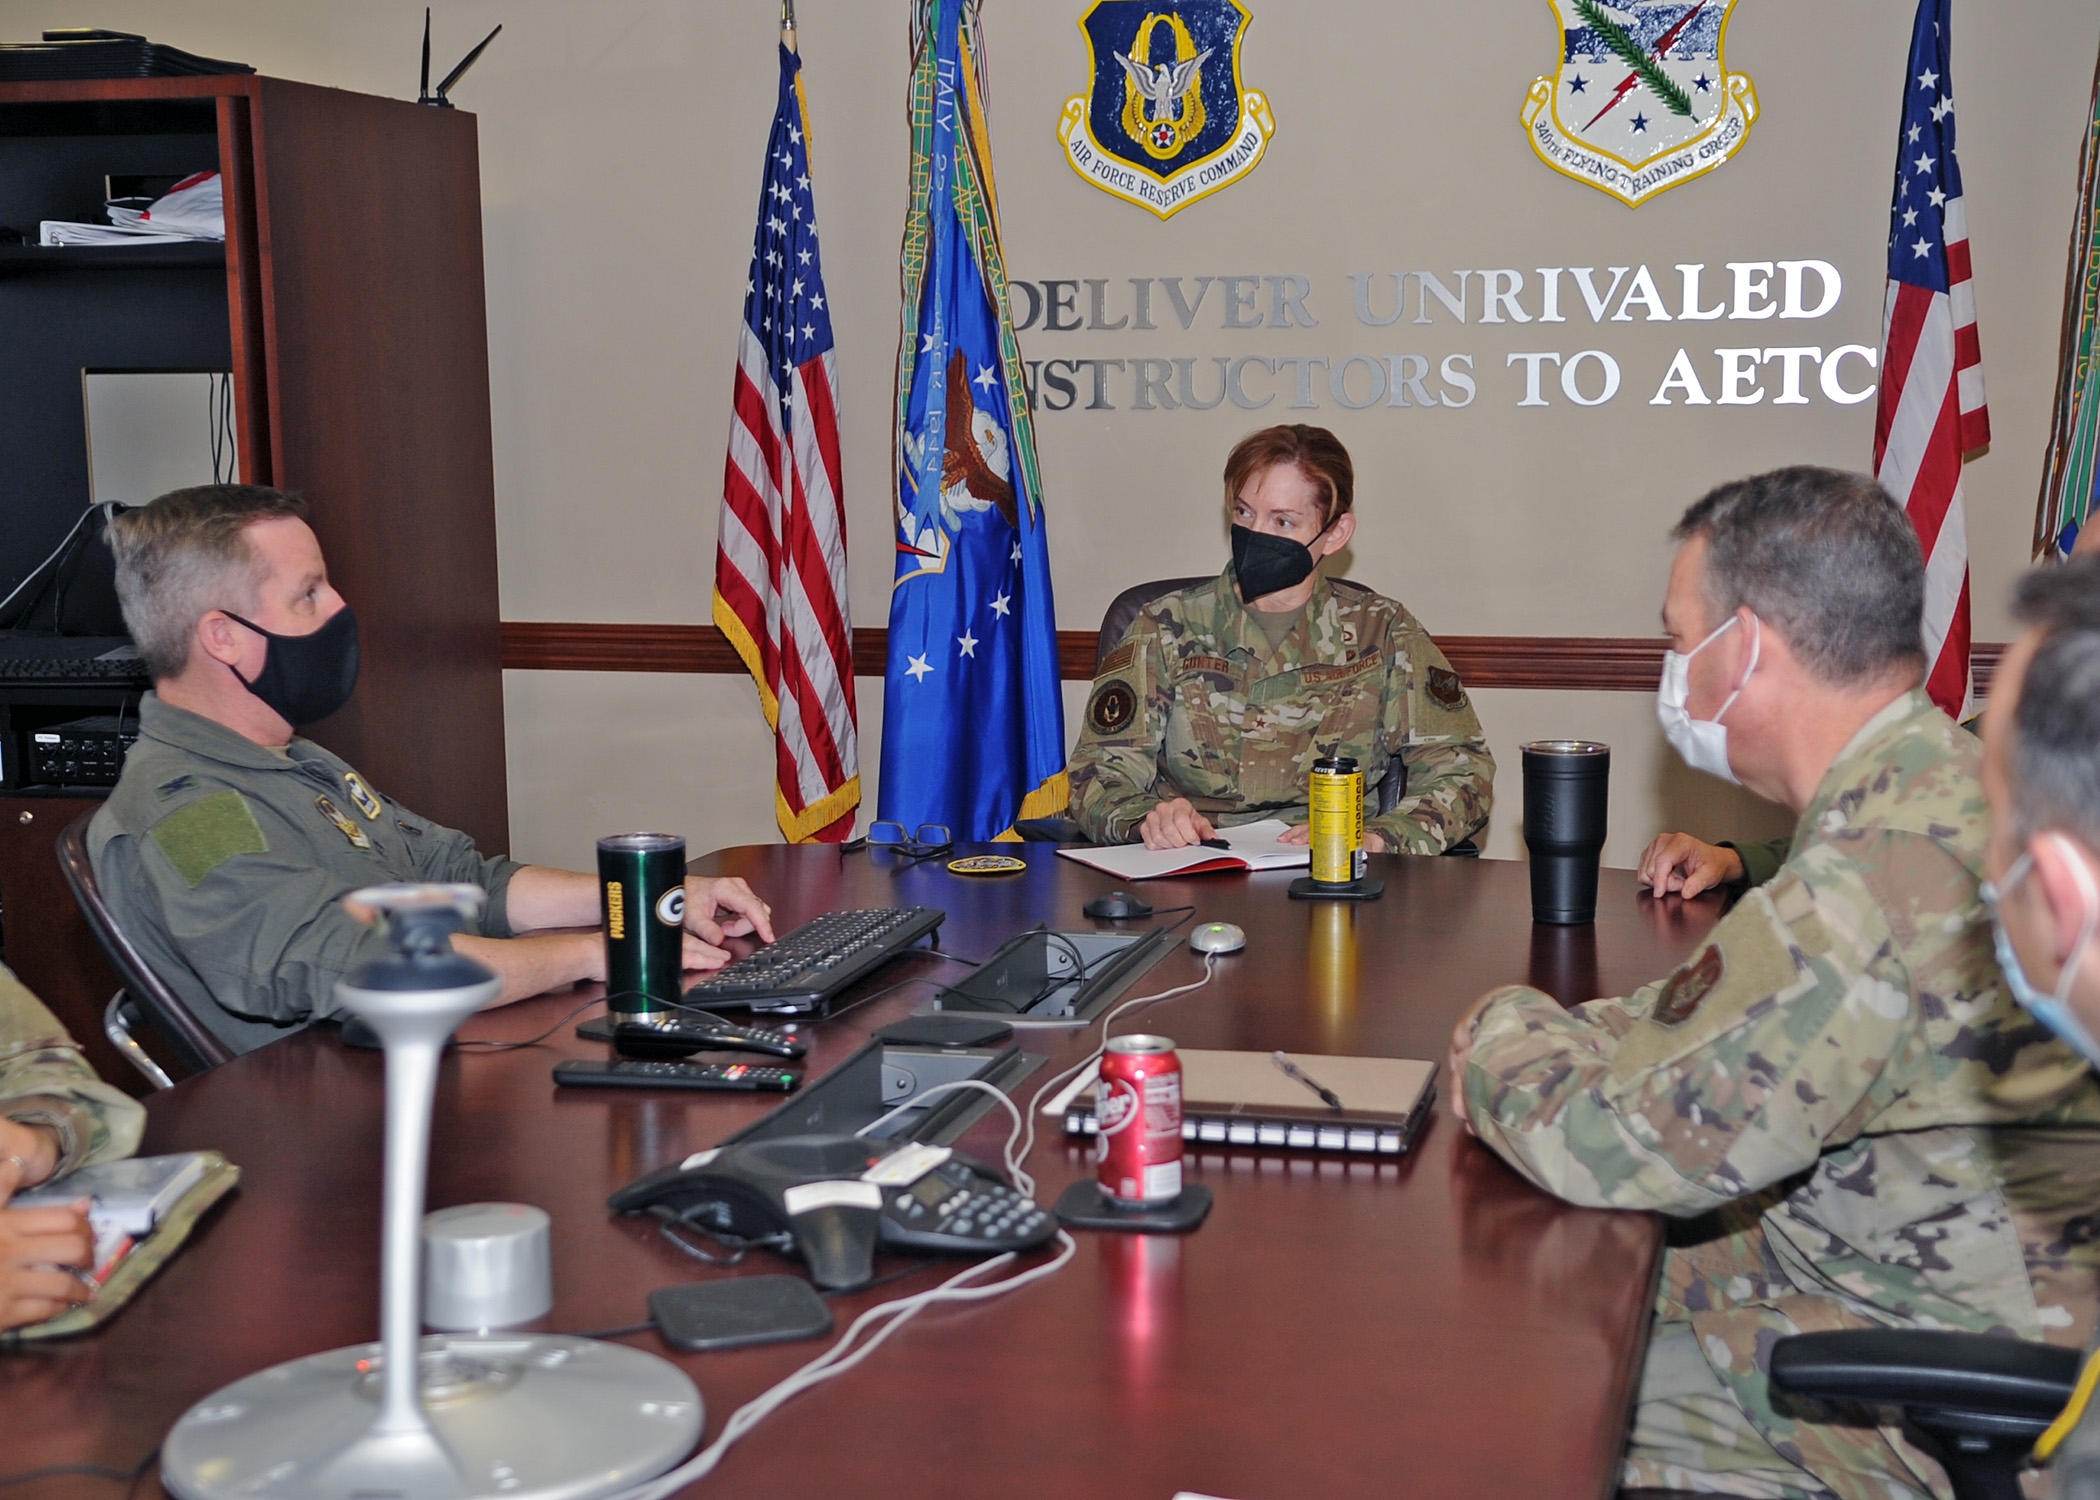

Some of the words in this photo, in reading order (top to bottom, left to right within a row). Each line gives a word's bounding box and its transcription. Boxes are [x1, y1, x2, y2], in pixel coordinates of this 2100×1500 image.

[937, 57, 956, 132] ITALY
[1070, 140, 1092, 165] AIR
[1091, 160, 1136, 193] FORCE
[1139, 176, 1197, 208] RESERVE
[1198, 131, 1260, 186] COMMAND
[1562, 149, 1616, 182] FLYING
[1619, 155, 1695, 195] TRAINING
[1347, 259, 1842, 327] UNRIVALED
[1024, 352, 1477, 412] STRUCTORS
[1506, 348, 1621, 407] TO
[1648, 344, 1878, 406] AETC
[607, 881, 624, 939] PACKERS
